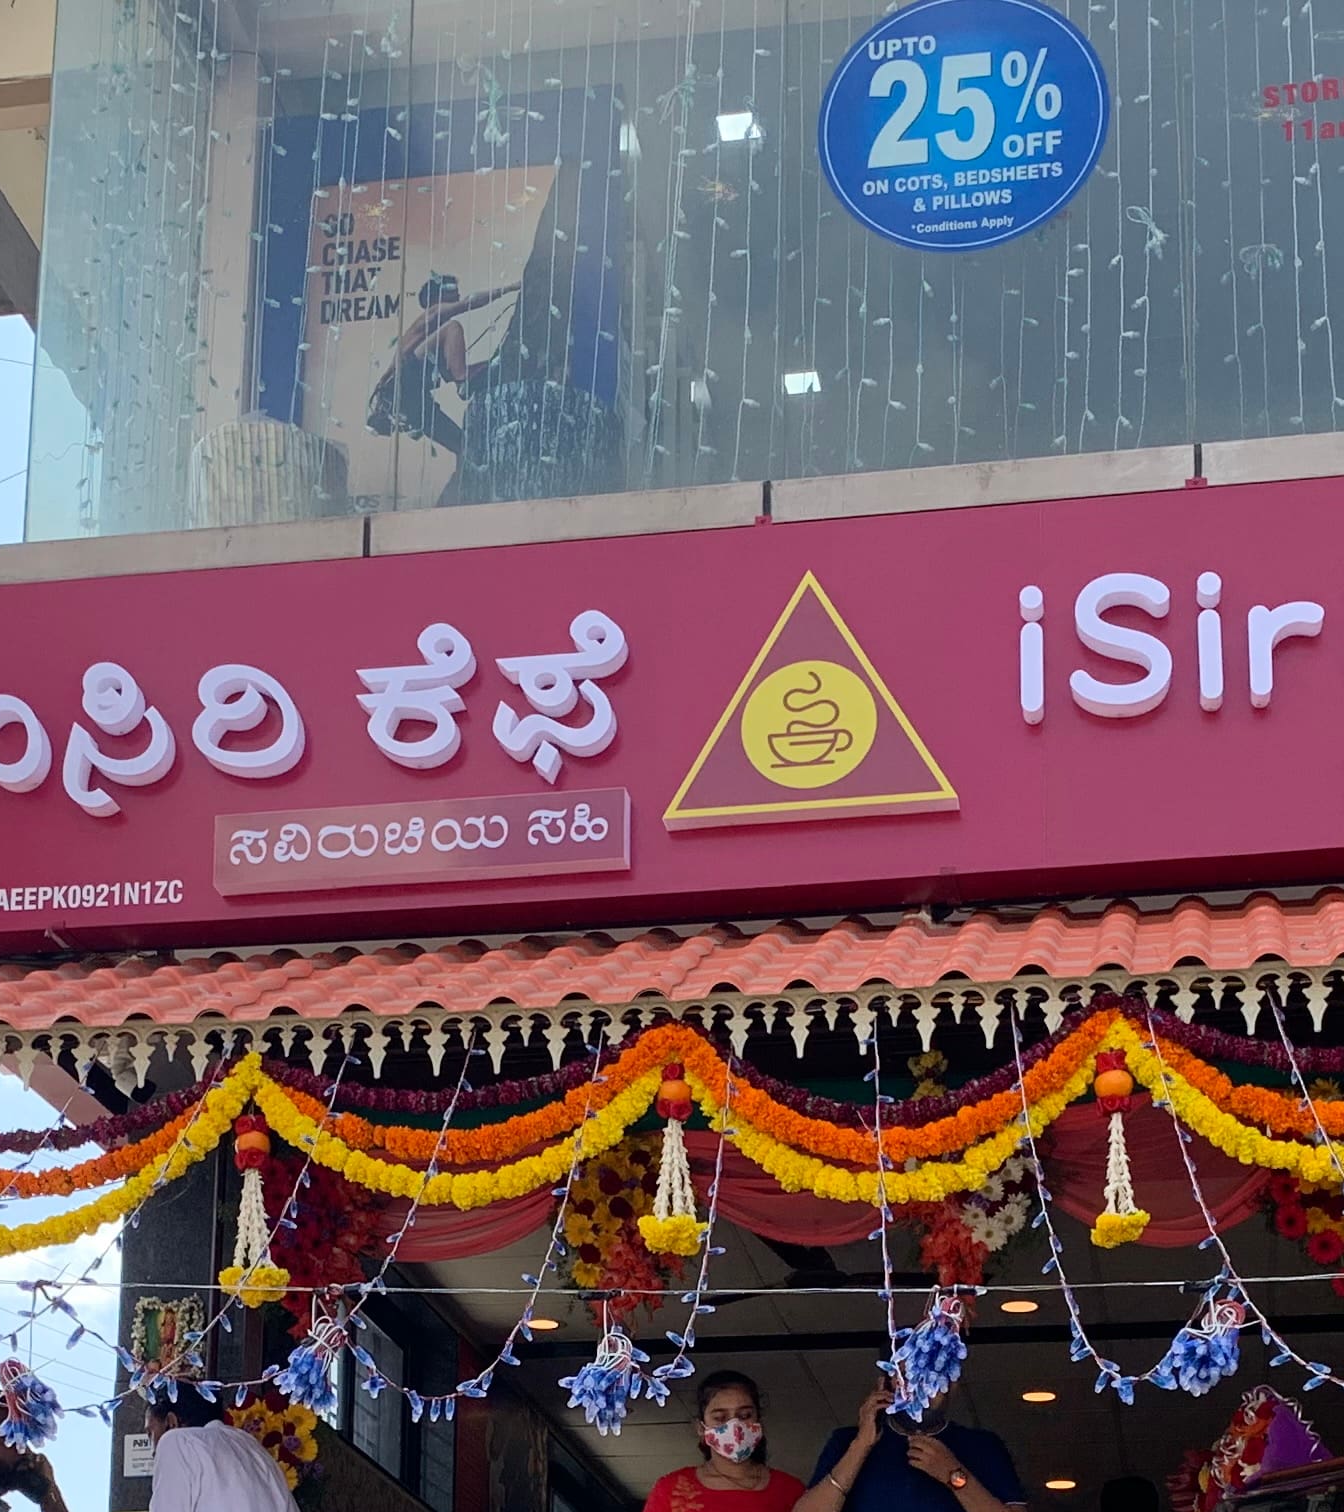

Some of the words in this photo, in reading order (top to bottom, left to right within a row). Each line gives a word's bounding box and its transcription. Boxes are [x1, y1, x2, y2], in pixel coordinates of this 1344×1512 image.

[868, 35, 937, 60] UPTO
[867, 47, 1063, 169] 25%
[1002, 131, 1063, 159] OFF
[862, 179, 889, 197] ON
[894, 173, 948, 194] COTS,
[953, 162, 1064, 187] BEDSHEETS
[912, 197, 927, 213] &
[932, 189, 1013, 211] PILLOWS
[980, 215, 1014, 230] Apply
[322, 236, 401, 266] CHASE
[322, 267, 382, 295] THAT
[320, 294, 401, 325] DREAM
